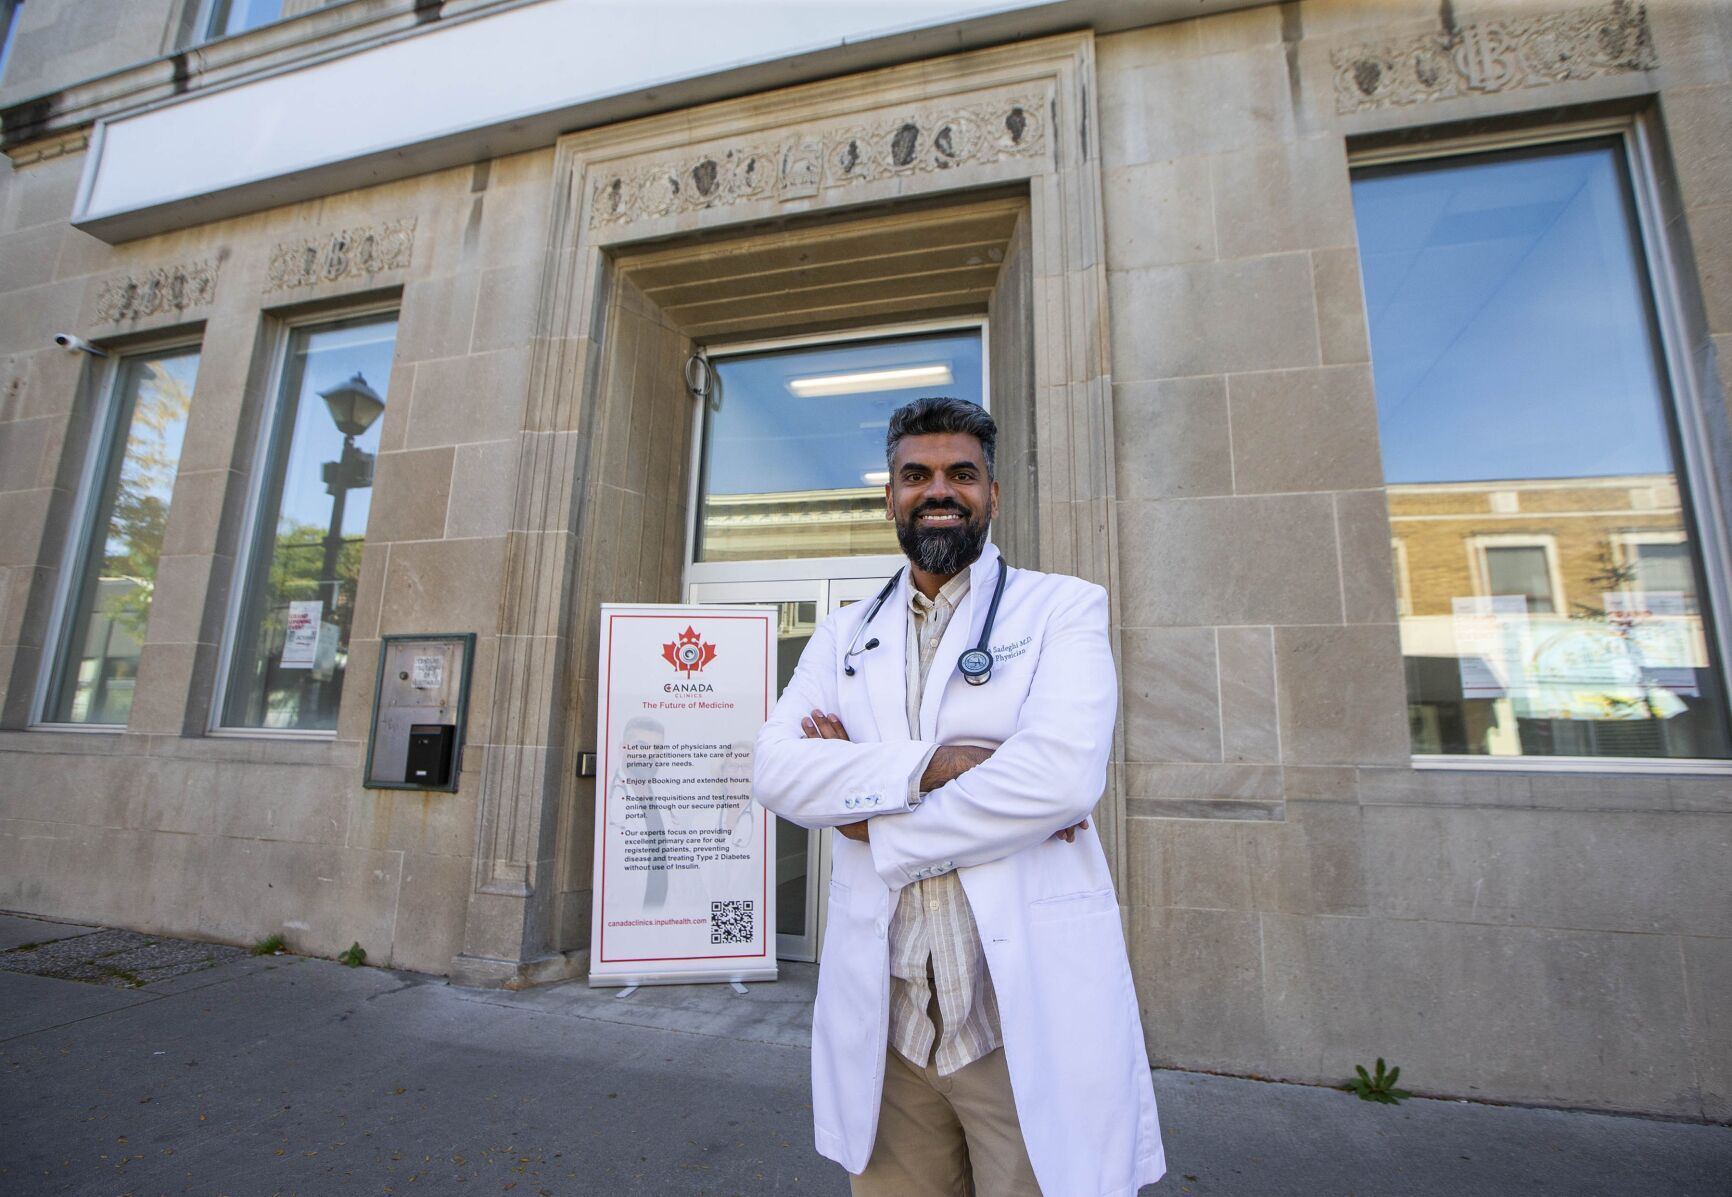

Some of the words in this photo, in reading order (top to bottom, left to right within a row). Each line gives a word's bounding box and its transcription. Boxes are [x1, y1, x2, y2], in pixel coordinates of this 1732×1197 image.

[992, 643, 1019, 654] Sadeghi
[995, 648, 1026, 662] Physician
[663, 683, 714, 693] CANADA
[688, 701, 697, 709] of
[698, 701, 734, 709] Medicine
[648, 752, 692, 760] practitioners
[625, 812, 648, 820] portal.
[639, 829, 666, 837] experts
[699, 828, 732, 836] providing
[720, 853, 751, 861] Diabetes
[608, 917, 707, 928] canadaclinics.inputhealth.com
